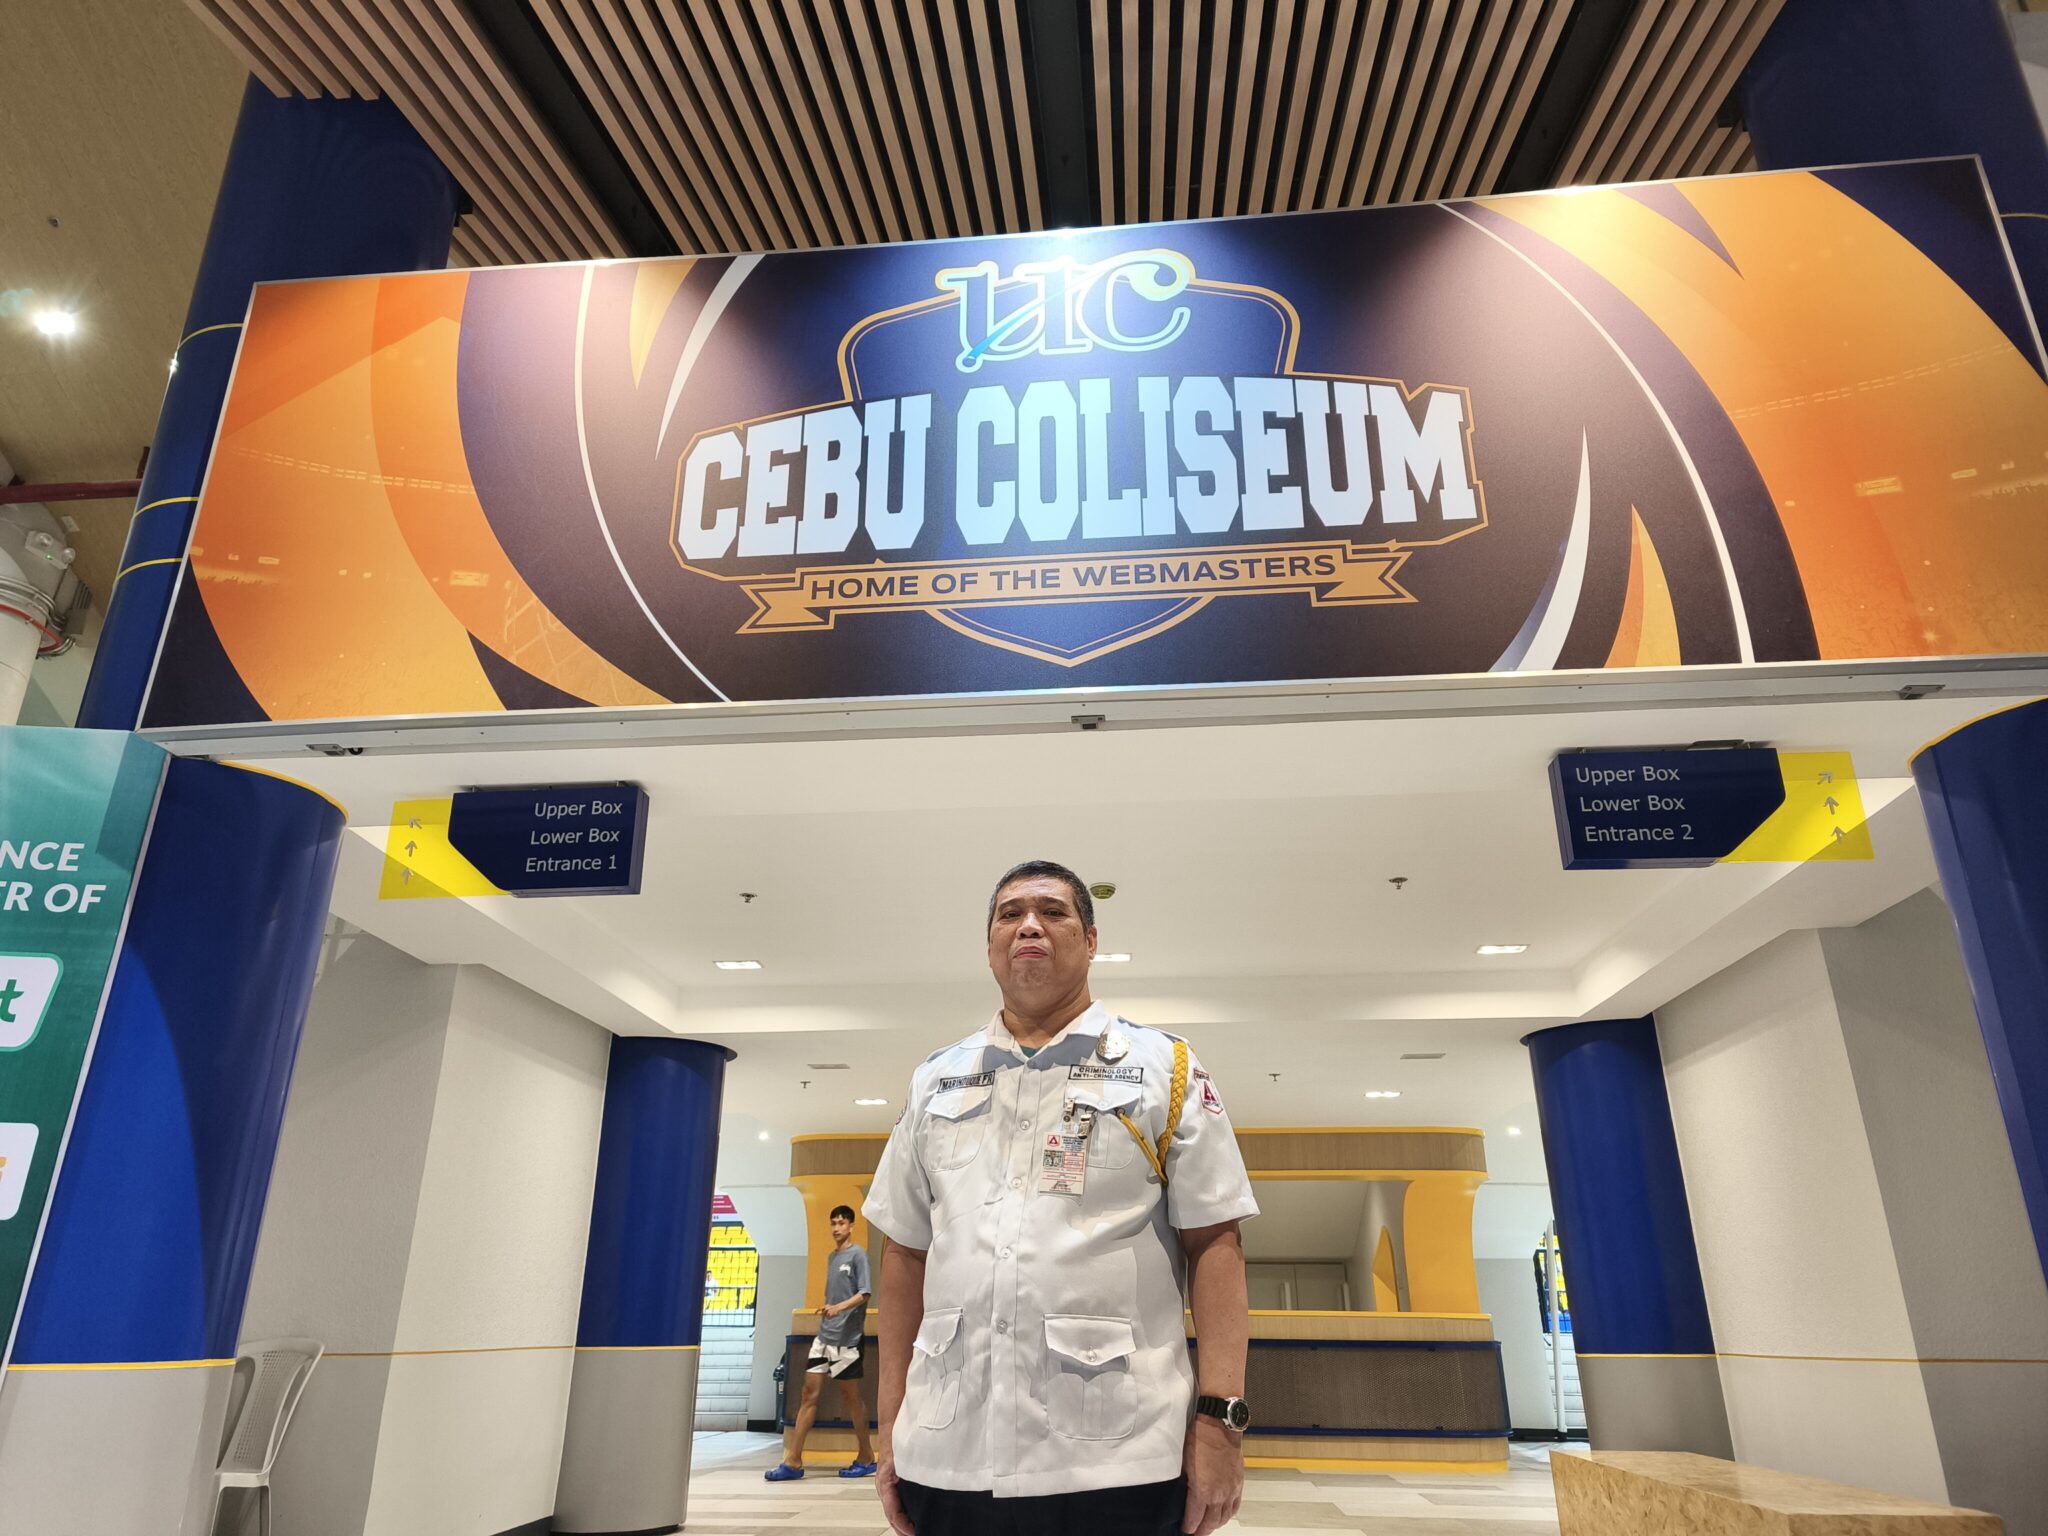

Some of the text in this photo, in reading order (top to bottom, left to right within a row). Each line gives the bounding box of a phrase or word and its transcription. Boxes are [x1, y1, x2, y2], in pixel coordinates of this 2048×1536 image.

[677, 376, 1478, 560] CEBU COLISEUM
[811, 554, 1336, 600] HOME OF THE WEBMASTERS
[1575, 765, 1681, 786] Upper Box
[534, 800, 623, 820] Upper Box
[1580, 795, 1686, 812] Lower Box
[530, 828, 621, 845] Lower Box
[1585, 824, 1695, 842] Entrance 2
[525, 854, 617, 872] Entrance 1
[44, 883, 107, 914] OF
[1073, 1072, 1113, 1080] ANTI-CRIME
[1078, 1067, 1134, 1076] CRIMINOLOGY
